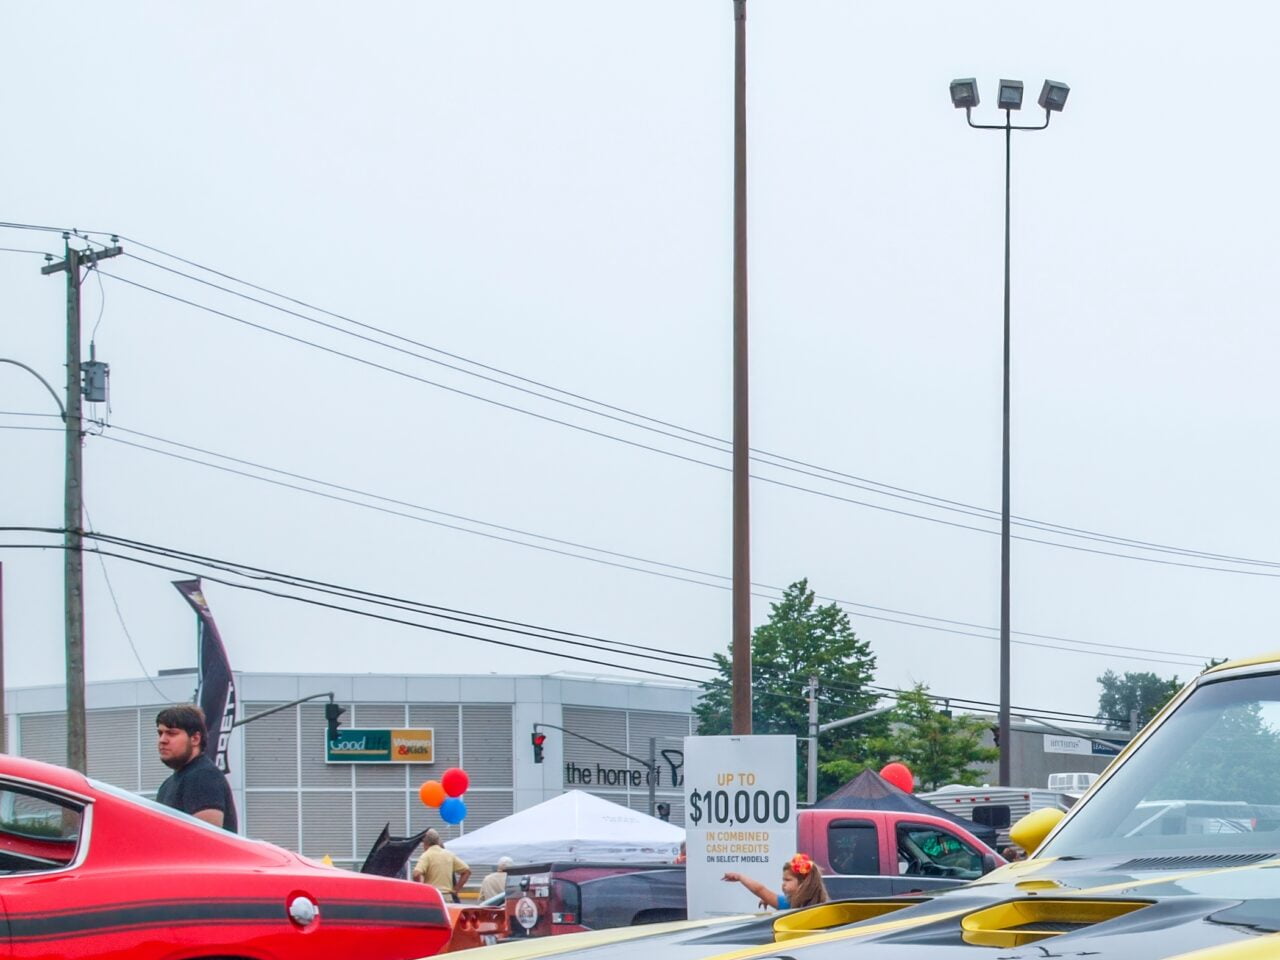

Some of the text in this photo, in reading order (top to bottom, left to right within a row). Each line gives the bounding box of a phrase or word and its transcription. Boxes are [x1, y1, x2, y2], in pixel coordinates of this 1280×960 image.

[566, 762, 592, 785] the
[597, 763, 641, 787] home
[717, 773, 755, 786] UP TO
[690, 788, 790, 827] $10,000
[706, 832, 769, 841] IN COMBINED
[706, 844, 769, 853] CASH CREDITS
[706, 855, 769, 863] ON SELECT MODELS
